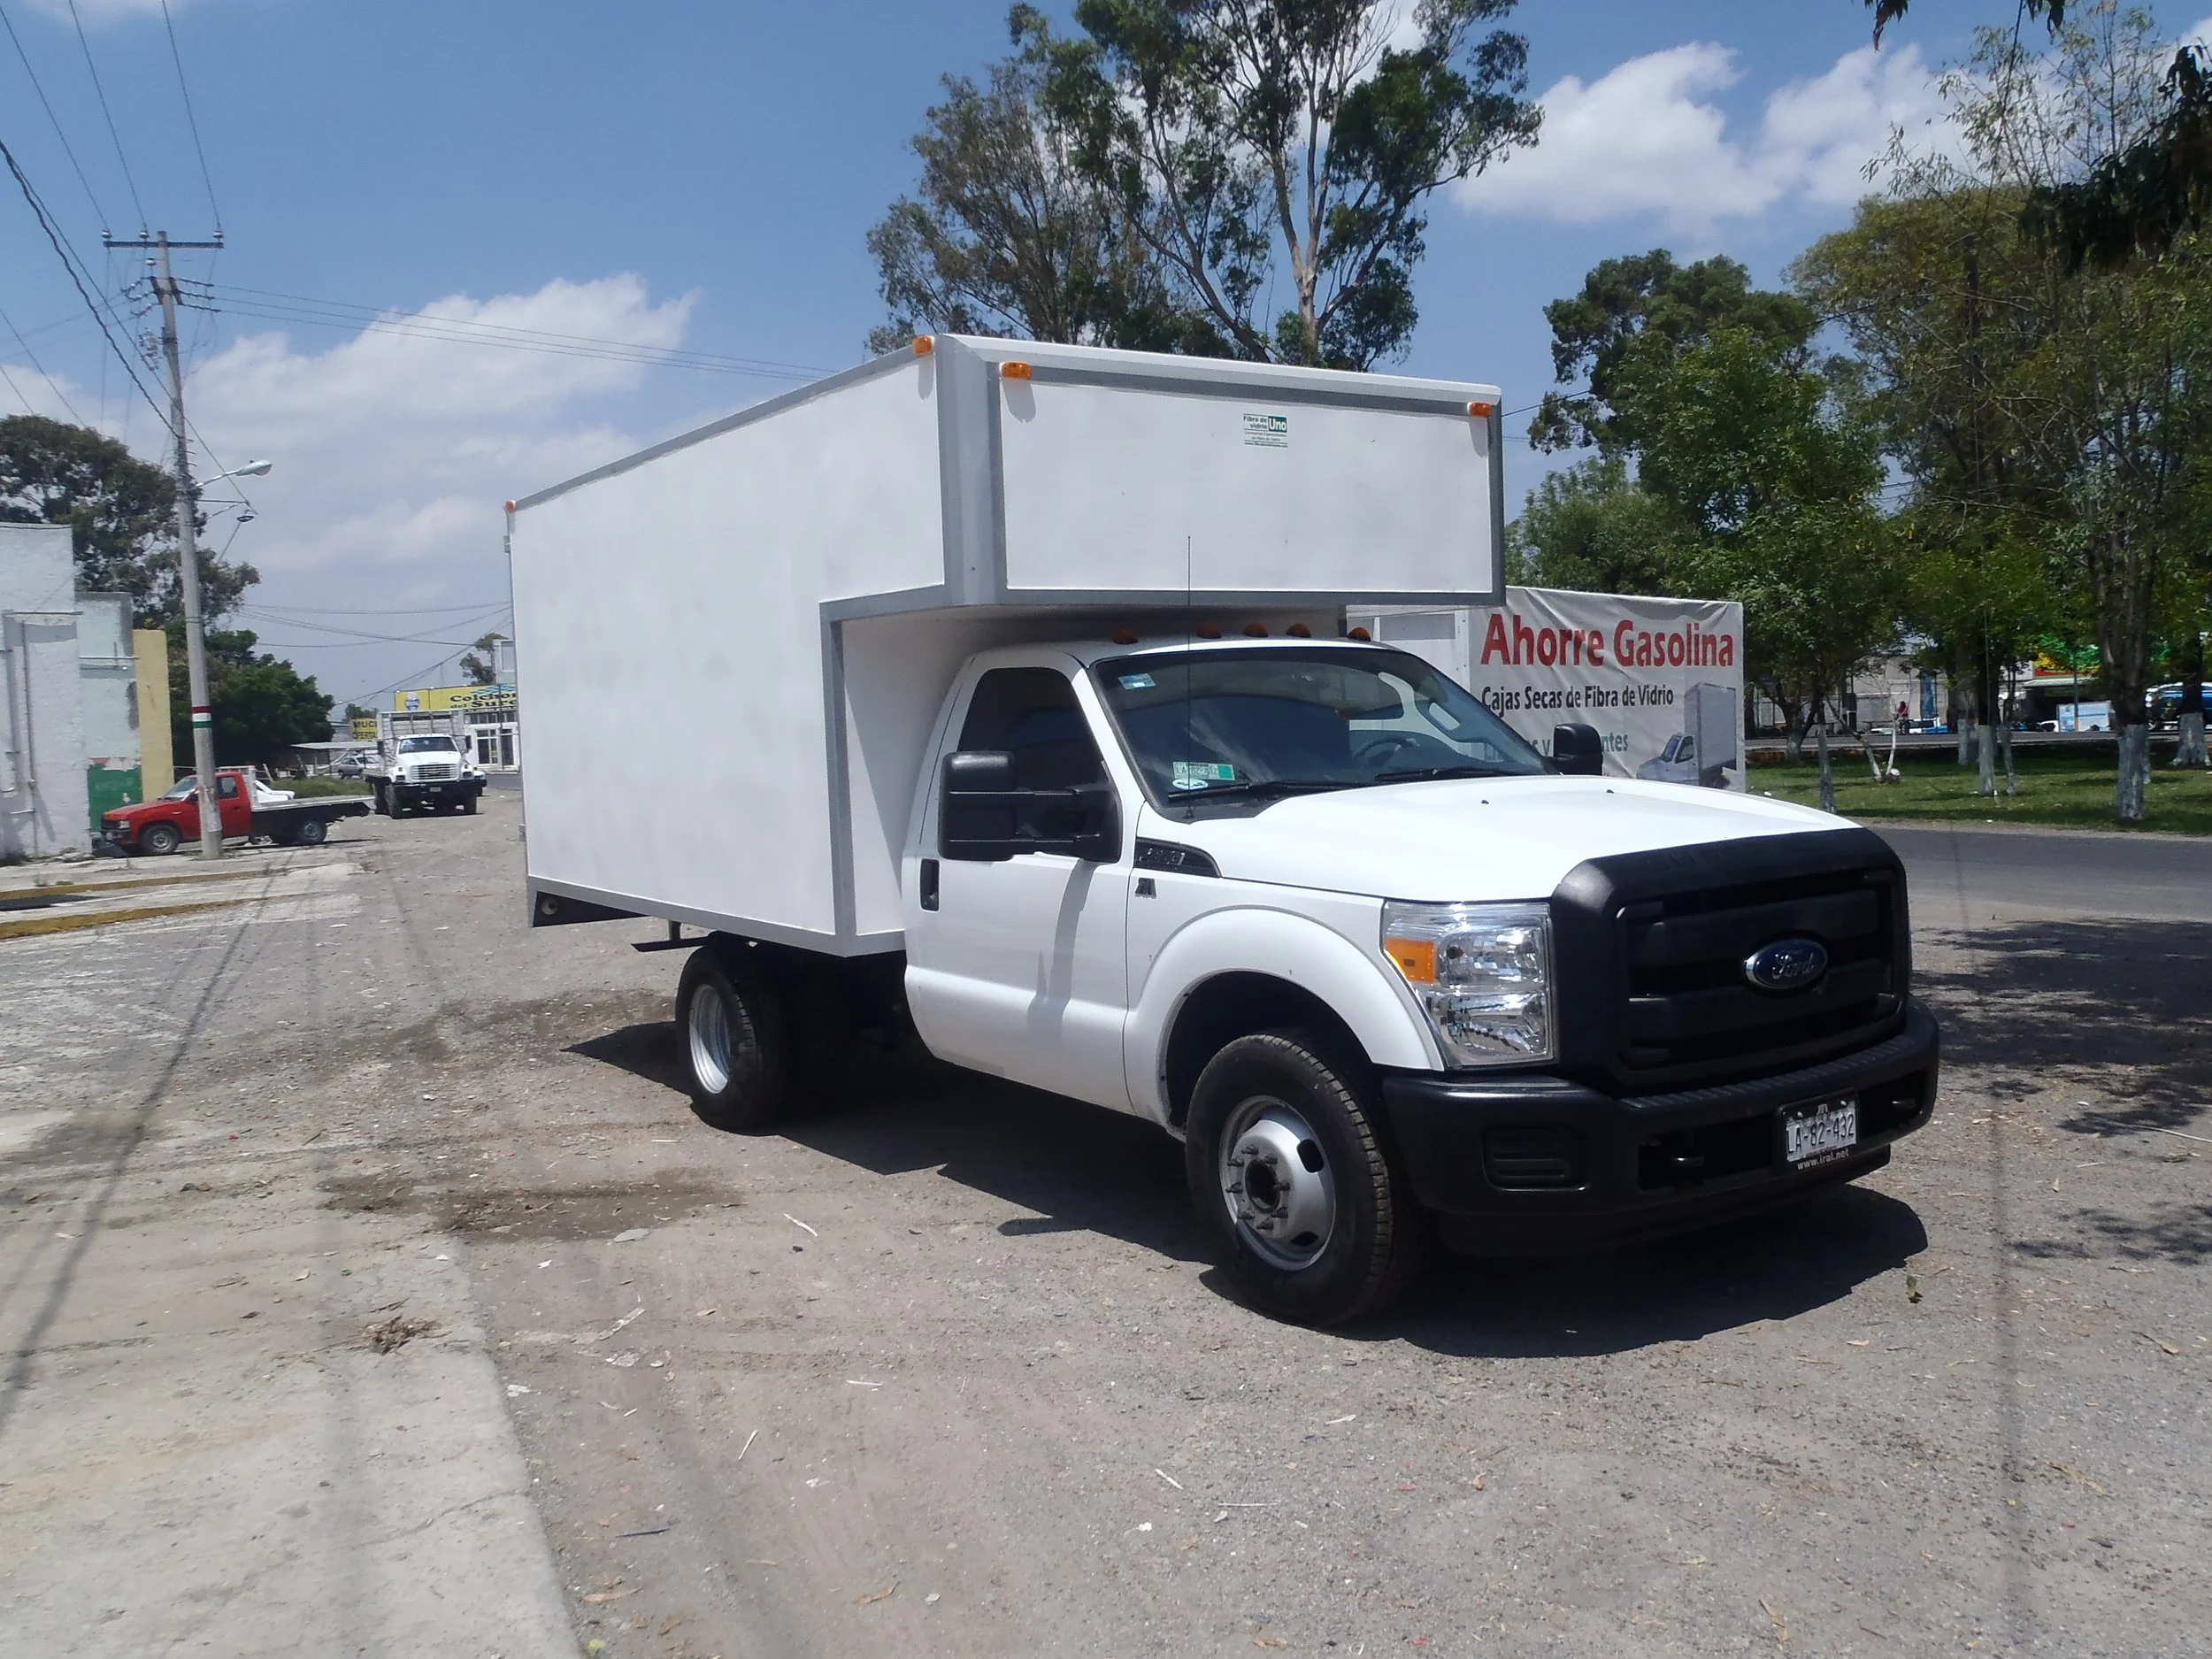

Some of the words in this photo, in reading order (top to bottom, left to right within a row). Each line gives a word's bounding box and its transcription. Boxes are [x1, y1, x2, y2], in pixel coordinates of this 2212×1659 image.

[1269, 417, 1286, 431] Uno
[1479, 612, 1604, 667] Ahorre
[1613, 619, 1734, 667] Gasolina
[1481, 686, 1520, 717] Cajas
[1524, 686, 1563, 710] Secas
[1565, 685, 1581, 708] de
[1585, 685, 1618, 708] Fibra
[1622, 685, 1636, 707] de
[1638, 684, 1674, 706] Vidrio
[1772, 950, 1815, 979] Ford
[1787, 1113, 1855, 1154] LA-82-432
